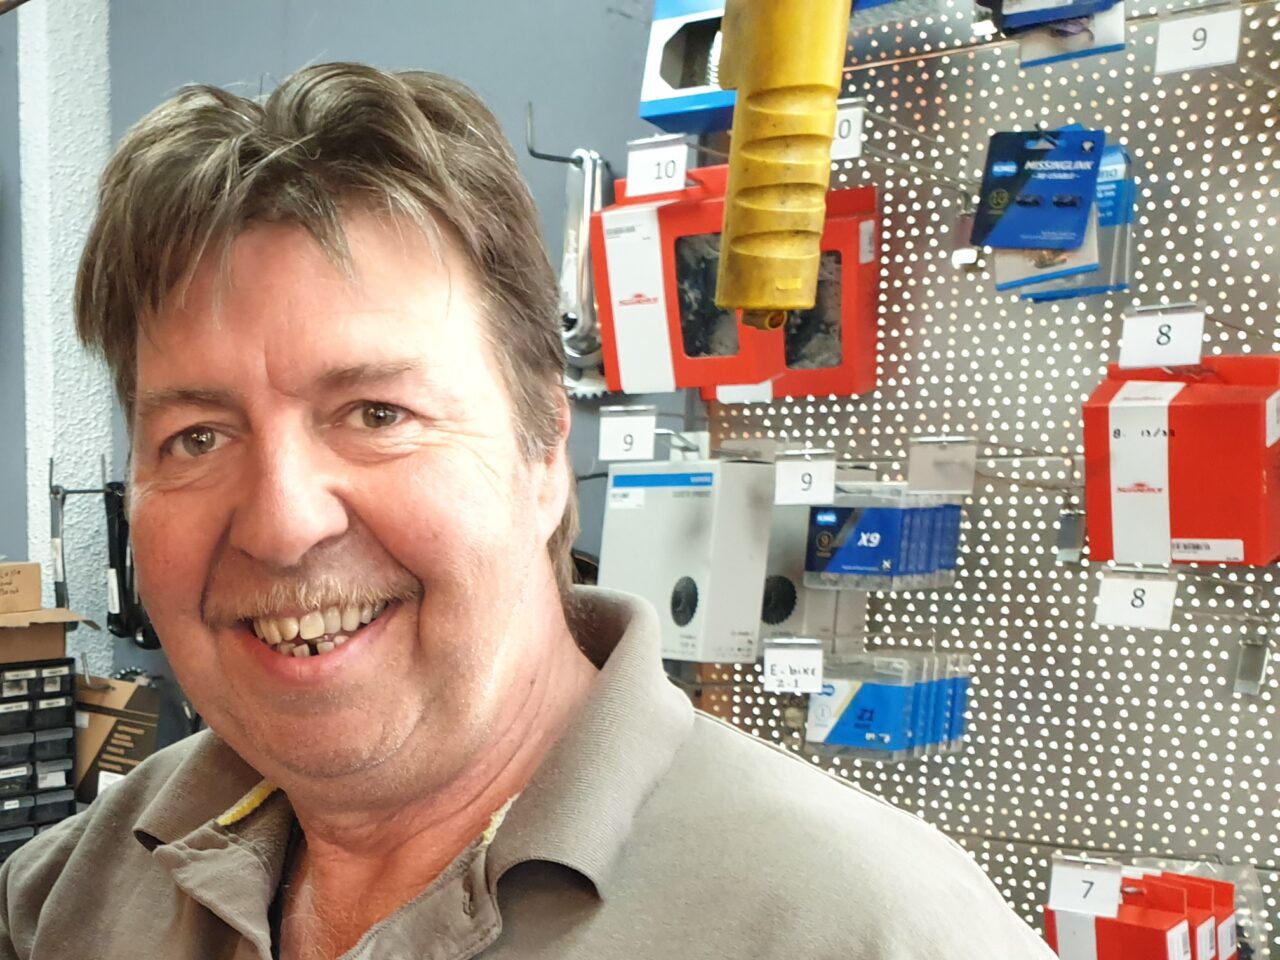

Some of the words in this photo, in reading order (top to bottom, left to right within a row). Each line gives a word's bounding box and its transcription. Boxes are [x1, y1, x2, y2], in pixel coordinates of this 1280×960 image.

[1191, 27, 1208, 51] 9
[832, 119, 852, 140] 0
[654, 160, 677, 180] 10
[1156, 324, 1172, 346] 8
[622, 433, 634, 452] 9
[801, 472, 813, 491] 9
[857, 531, 881, 548] X9
[1130, 587, 1146, 609] 8
[1081, 880, 1095, 899] 7
